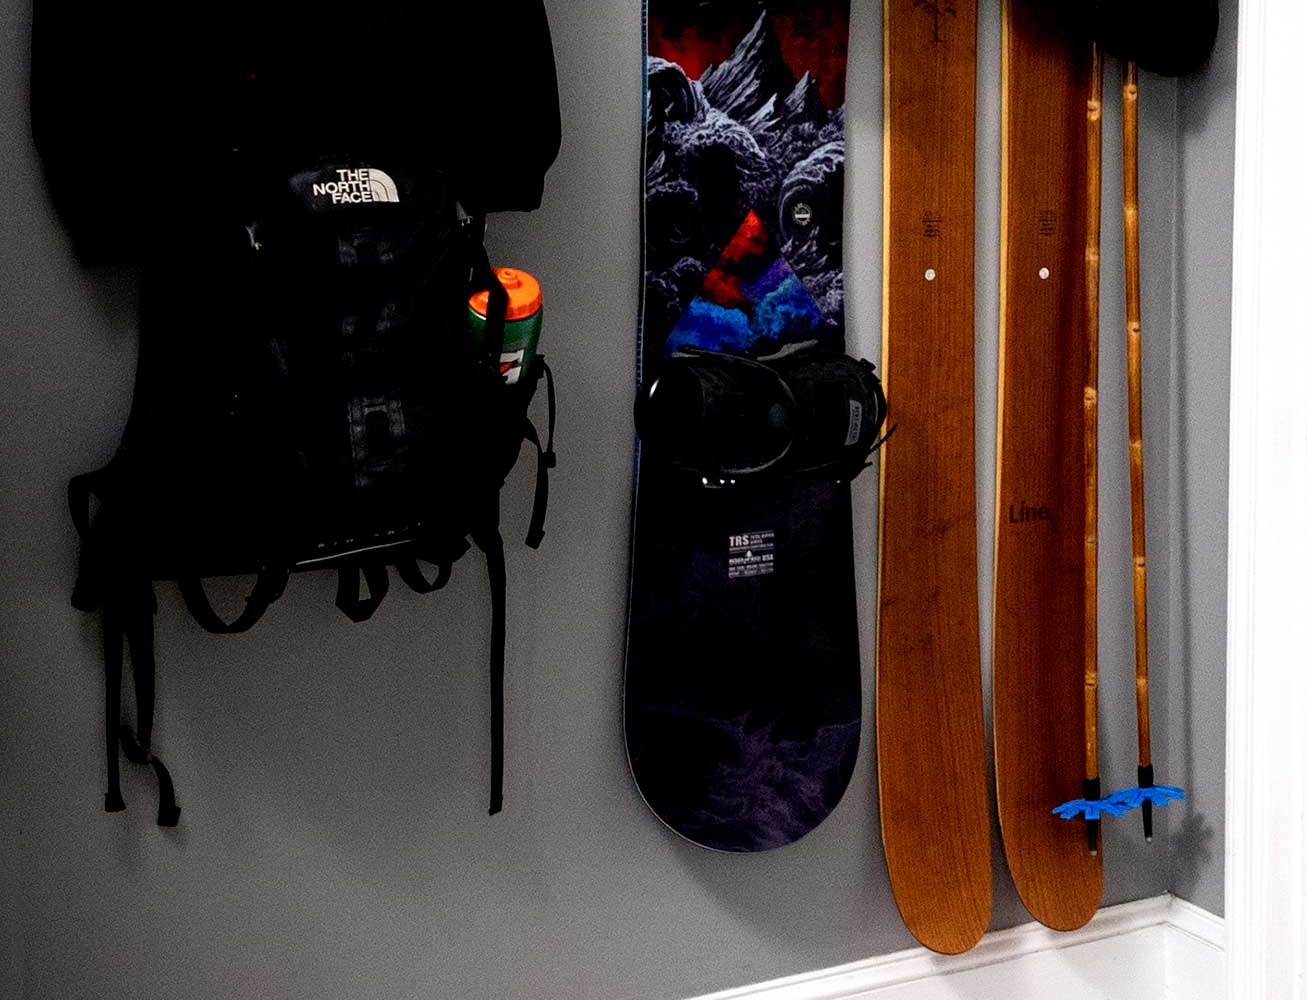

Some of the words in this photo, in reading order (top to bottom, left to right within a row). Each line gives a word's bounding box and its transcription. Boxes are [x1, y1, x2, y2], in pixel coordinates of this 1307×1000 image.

[336, 169, 369, 181] THE
[313, 180, 370, 196] NORTH
[332, 191, 373, 204] FACE
[729, 535, 749, 547] TRS
